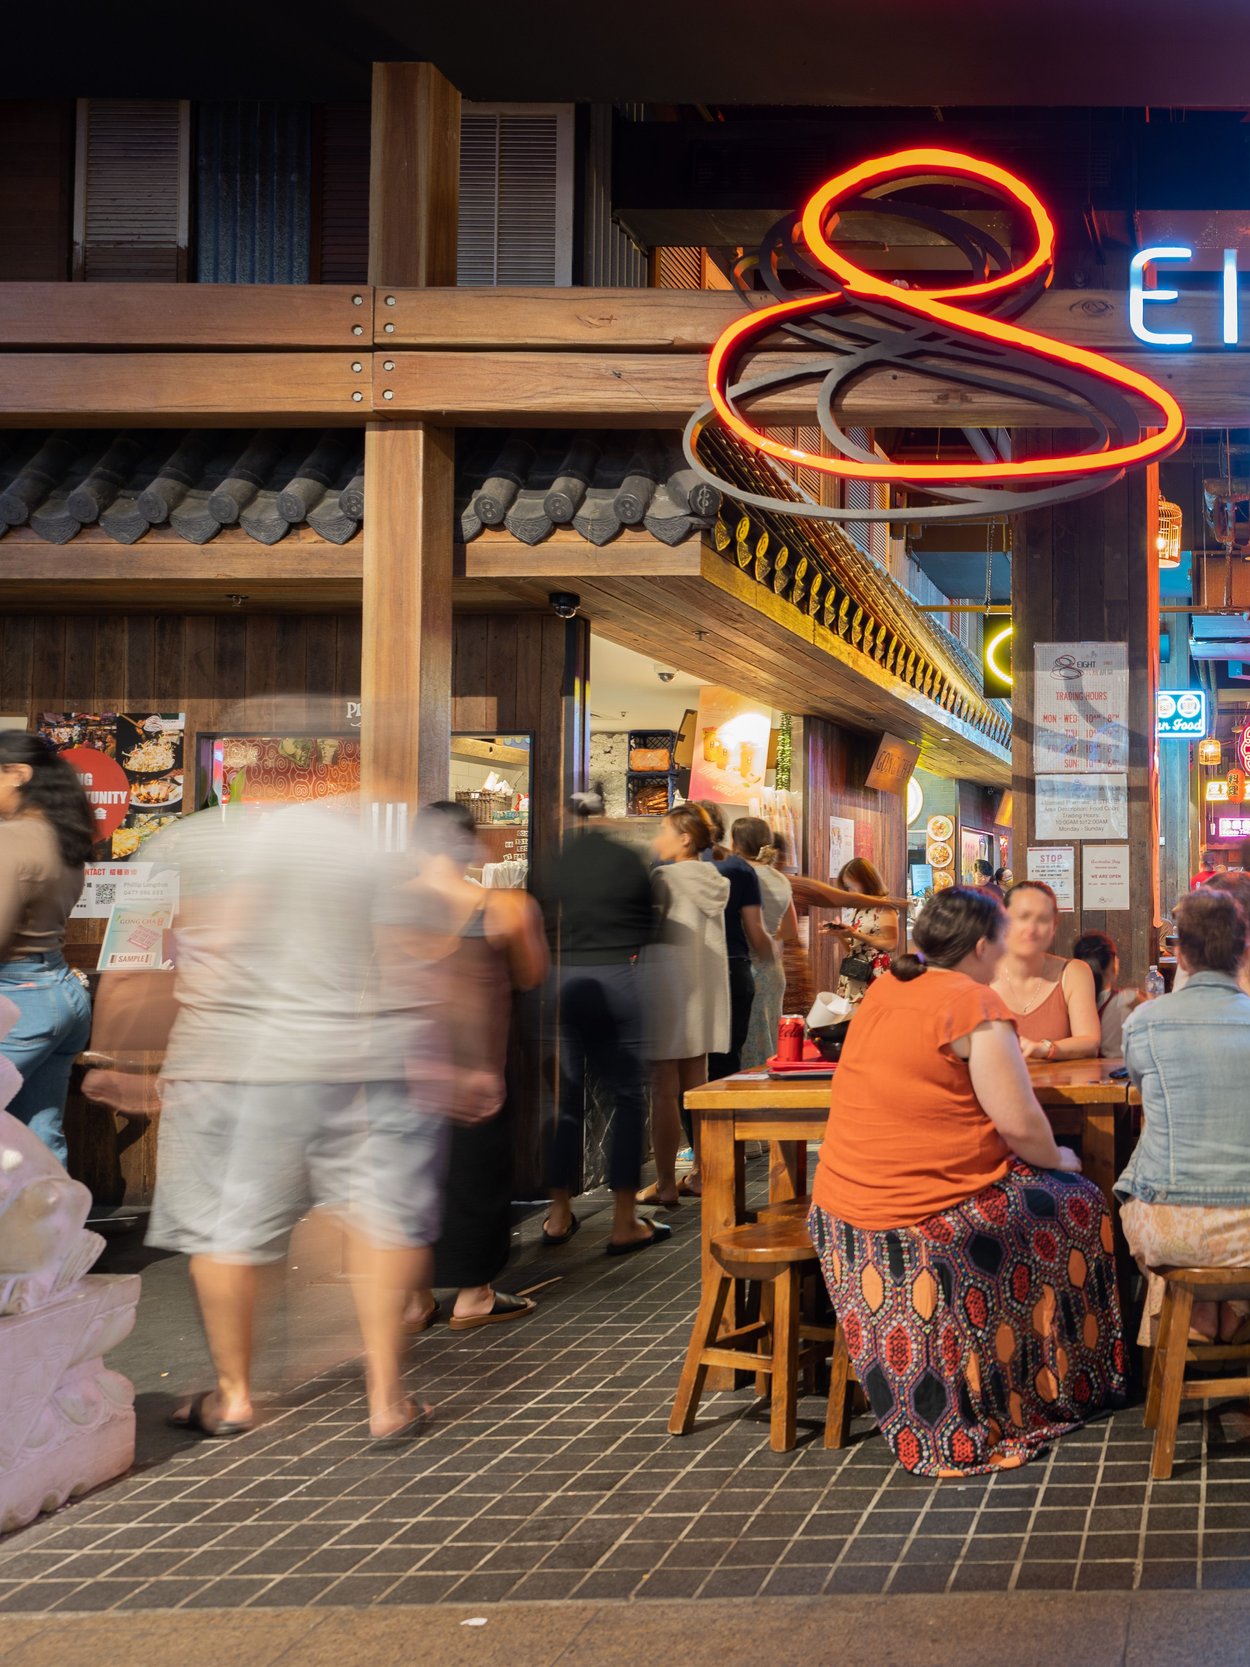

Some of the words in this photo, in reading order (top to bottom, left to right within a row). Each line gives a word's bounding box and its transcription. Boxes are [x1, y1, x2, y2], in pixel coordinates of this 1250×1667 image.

[1056, 691, 1084, 701] TRADING
[1085, 691, 1108, 701] HOURS
[1042, 714, 1057, 723] MON
[1172, 718, 1203, 731] Food
[1040, 854, 1063, 863] STOP
[118, 954, 145, 963] SAMPLE
